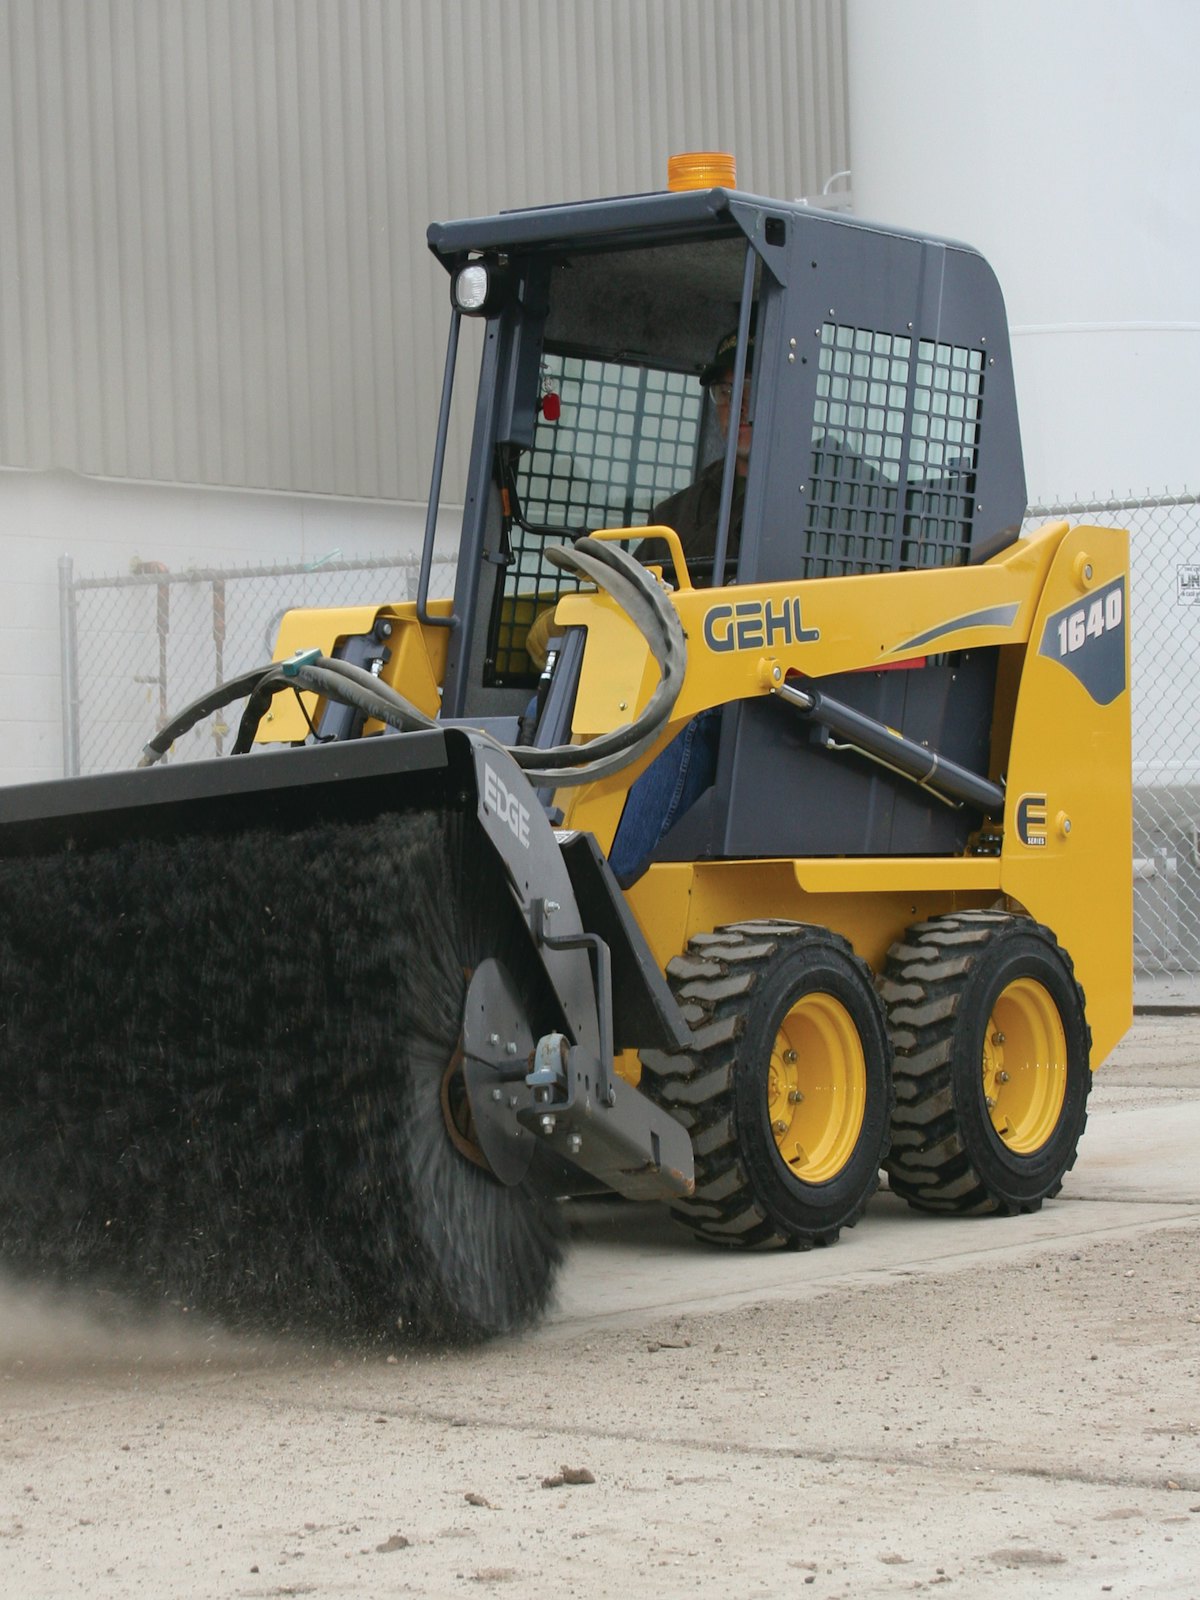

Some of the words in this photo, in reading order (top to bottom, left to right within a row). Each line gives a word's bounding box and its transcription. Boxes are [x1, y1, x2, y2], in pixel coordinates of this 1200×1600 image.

[703, 596, 820, 654] GEHL
[1057, 587, 1122, 657] 1640
[484, 762, 530, 849] EDGE
[1016, 795, 1047, 847] E
